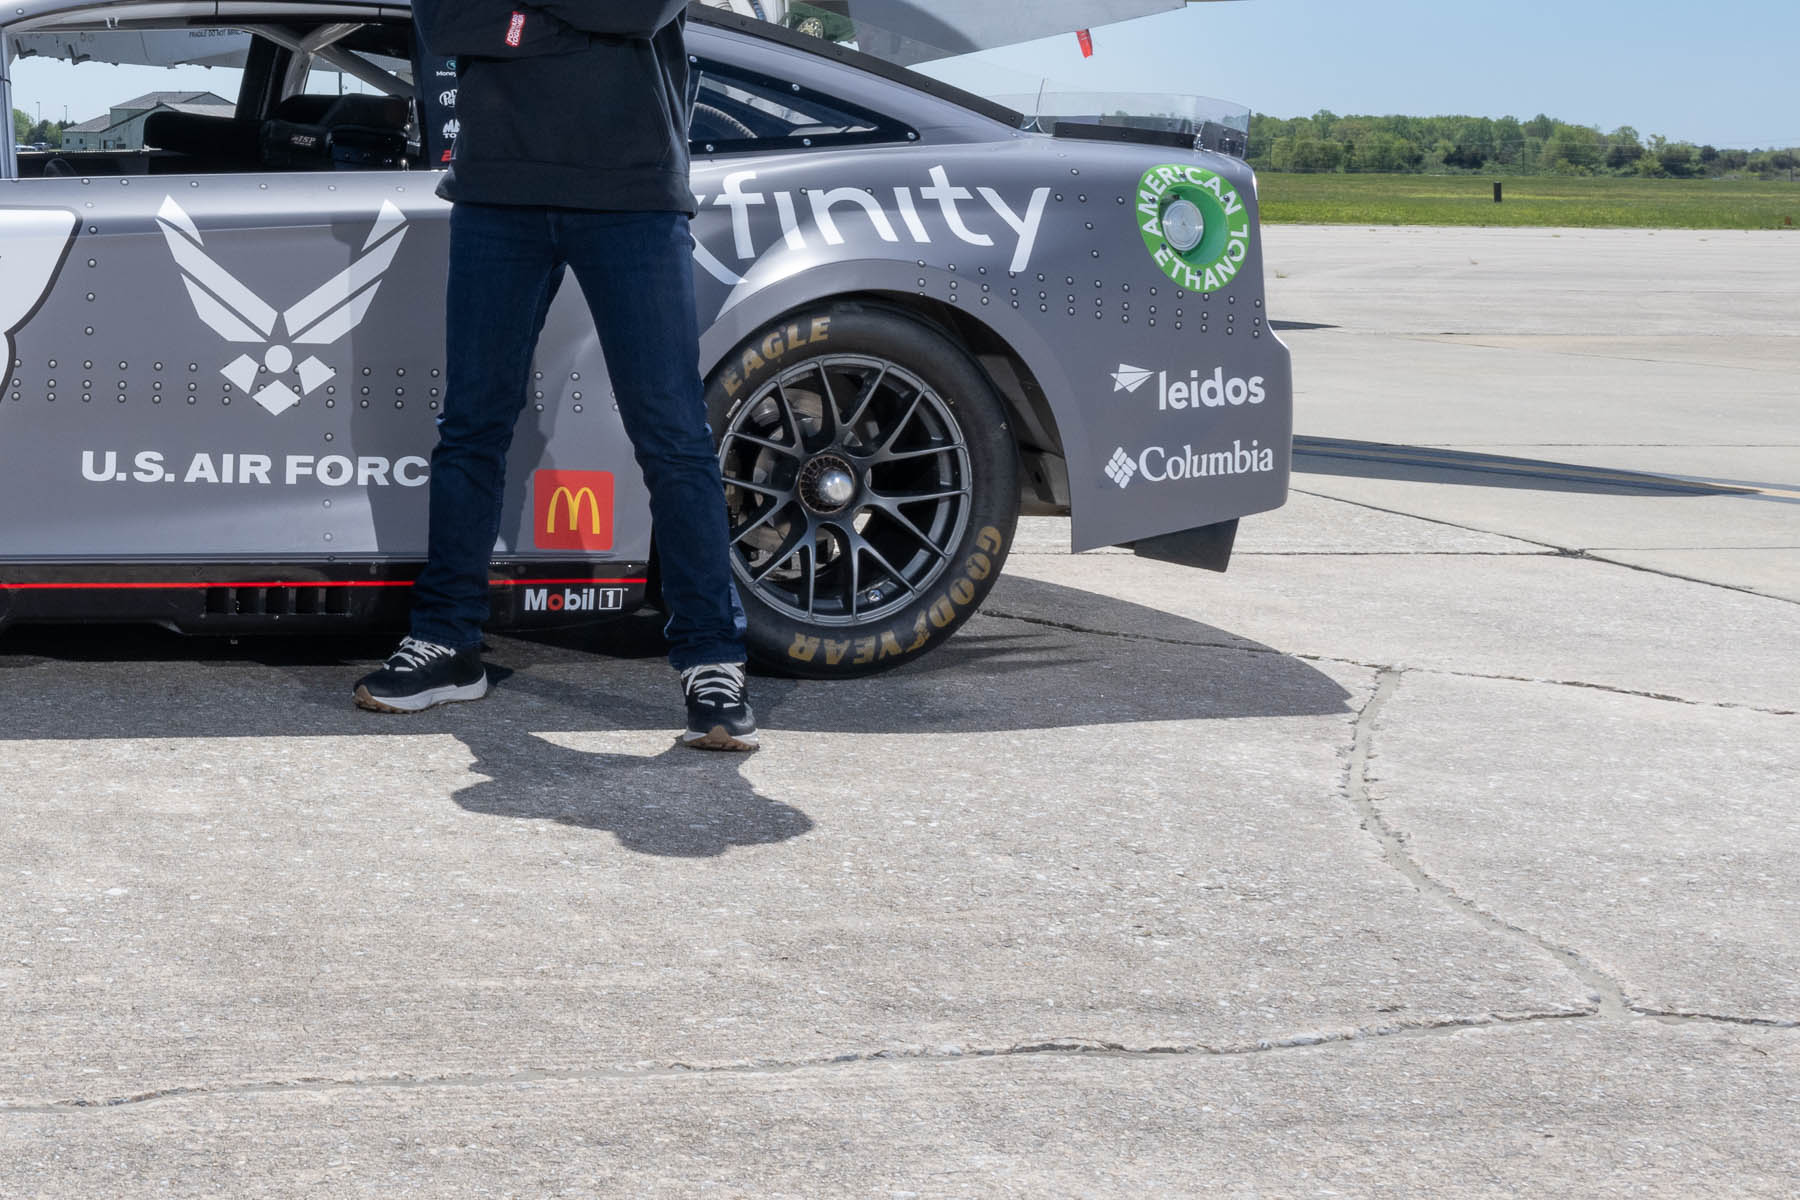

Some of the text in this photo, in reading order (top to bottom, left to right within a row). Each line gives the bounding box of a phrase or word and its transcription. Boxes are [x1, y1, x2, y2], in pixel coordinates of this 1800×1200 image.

[1138, 167, 1242, 237] AMERICAN
[1154, 224, 1248, 290] ETHANOL
[720, 316, 832, 397] EAGLE
[1159, 367, 1265, 410] leidos
[82, 451, 430, 487] U.S. AIR FORC
[1139, 440, 1274, 481] Columbia
[524, 588, 595, 611] Mobil
